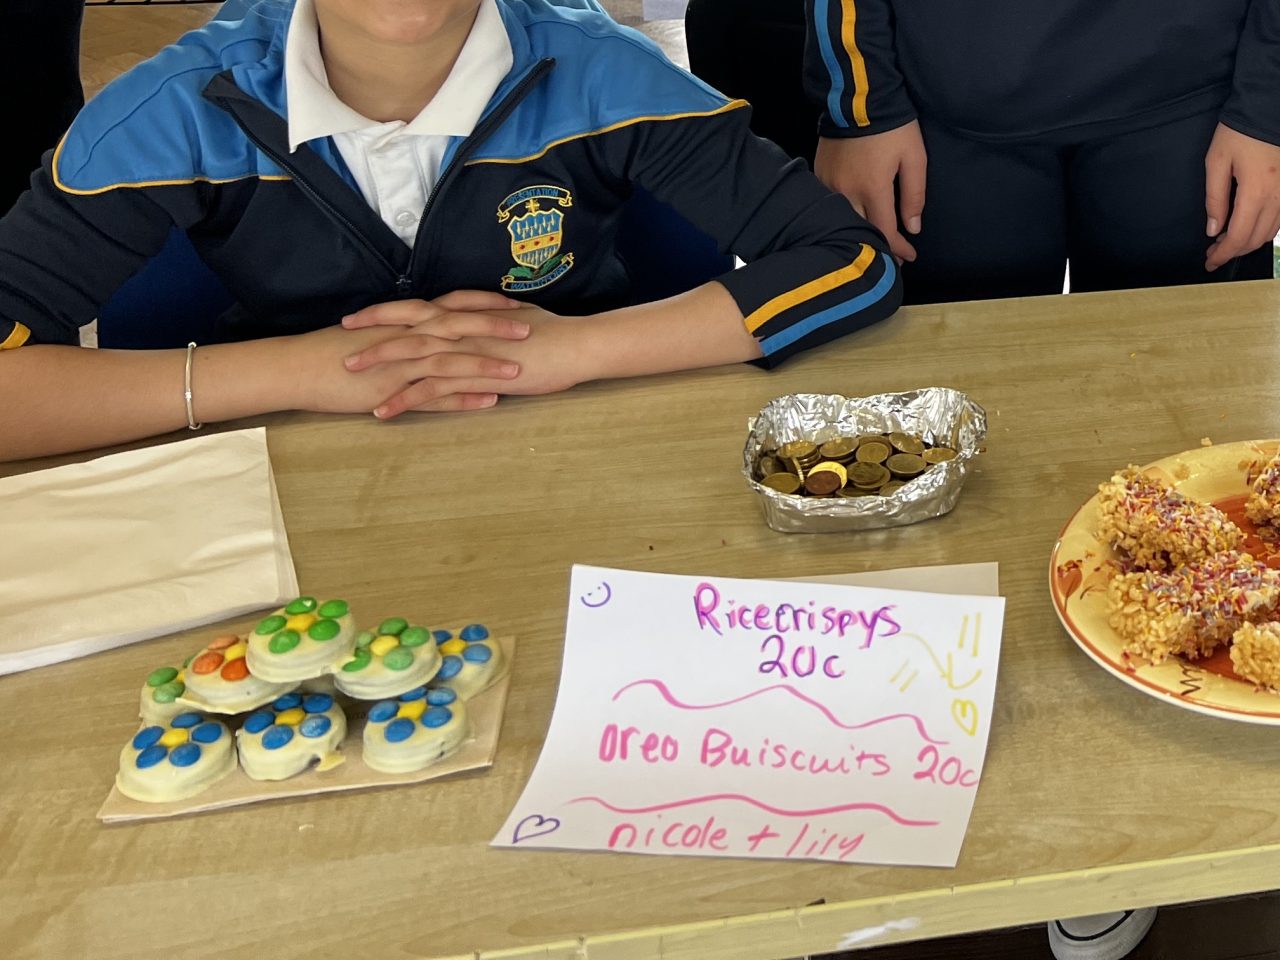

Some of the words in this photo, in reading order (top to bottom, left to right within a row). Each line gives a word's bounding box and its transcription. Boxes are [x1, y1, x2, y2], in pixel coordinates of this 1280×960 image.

[693, 582, 901, 649] Ricecrispys
[700, 728, 891, 776] Buiscuits
[913, 745, 979, 787] 20c
[747, 825, 780, 851] +
